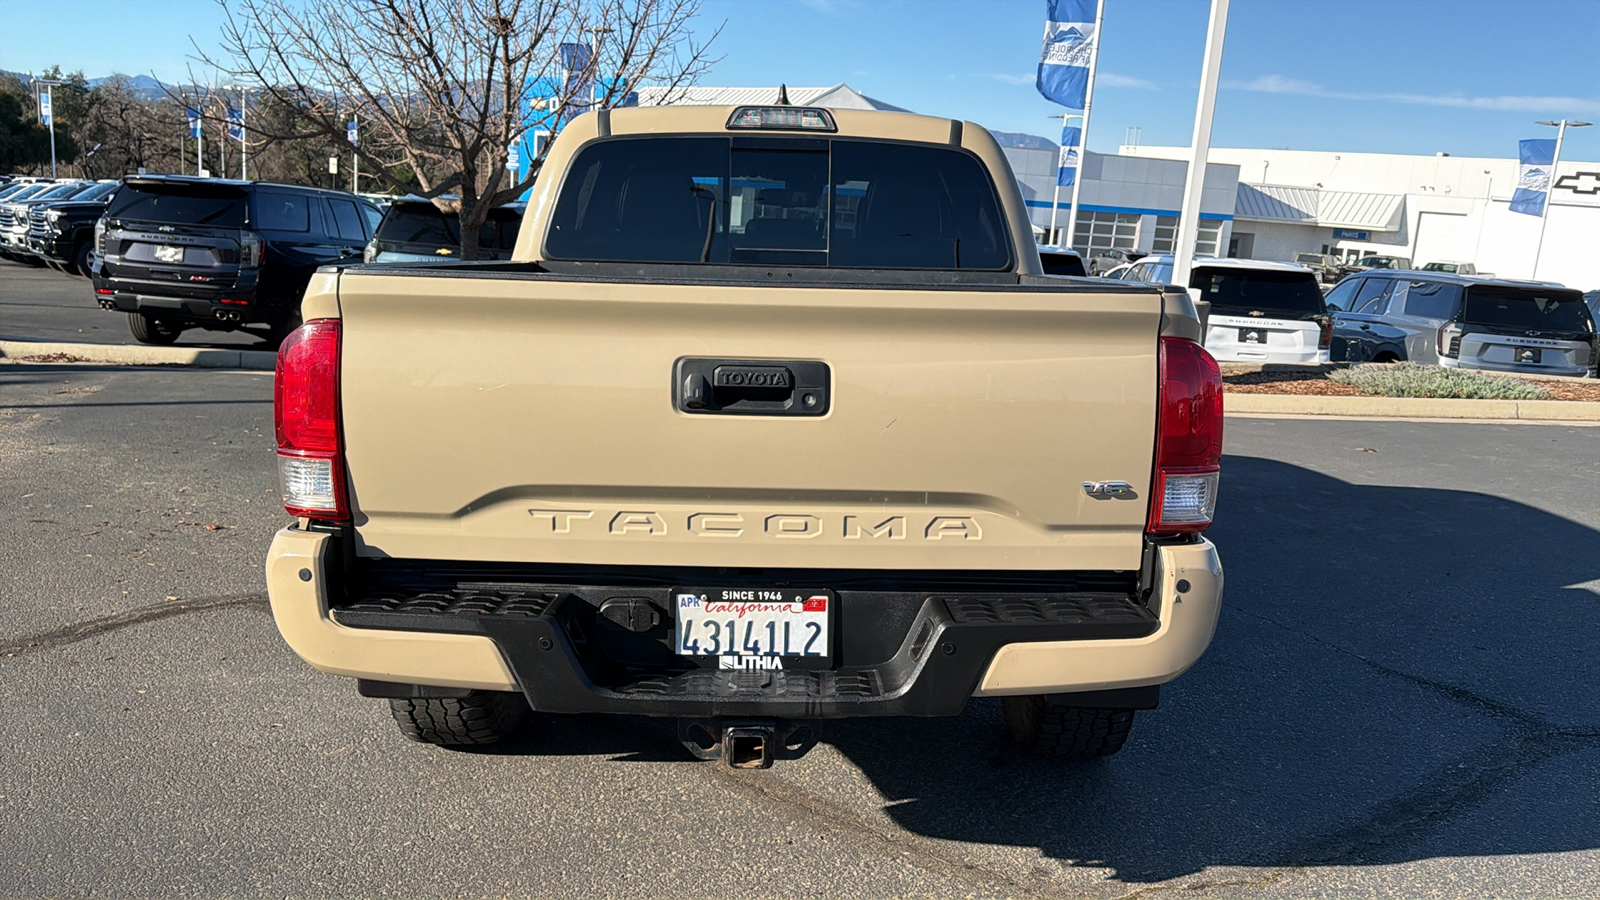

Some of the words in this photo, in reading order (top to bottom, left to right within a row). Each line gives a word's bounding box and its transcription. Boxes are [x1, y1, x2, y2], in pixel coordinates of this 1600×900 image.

[1341, 230, 1359, 239] PARTS
[721, 371, 787, 386] TOYOTA
[1082, 482, 1132, 496] V6
[528, 508, 983, 541] TACOMA
[680, 597, 700, 608] APR
[722, 590, 755, 600] SINCE
[758, 591, 783, 601] 1946
[704, 601, 803, 619] California
[682, 619, 822, 657] 43141L2
[734, 656, 783, 670] LITHIA
